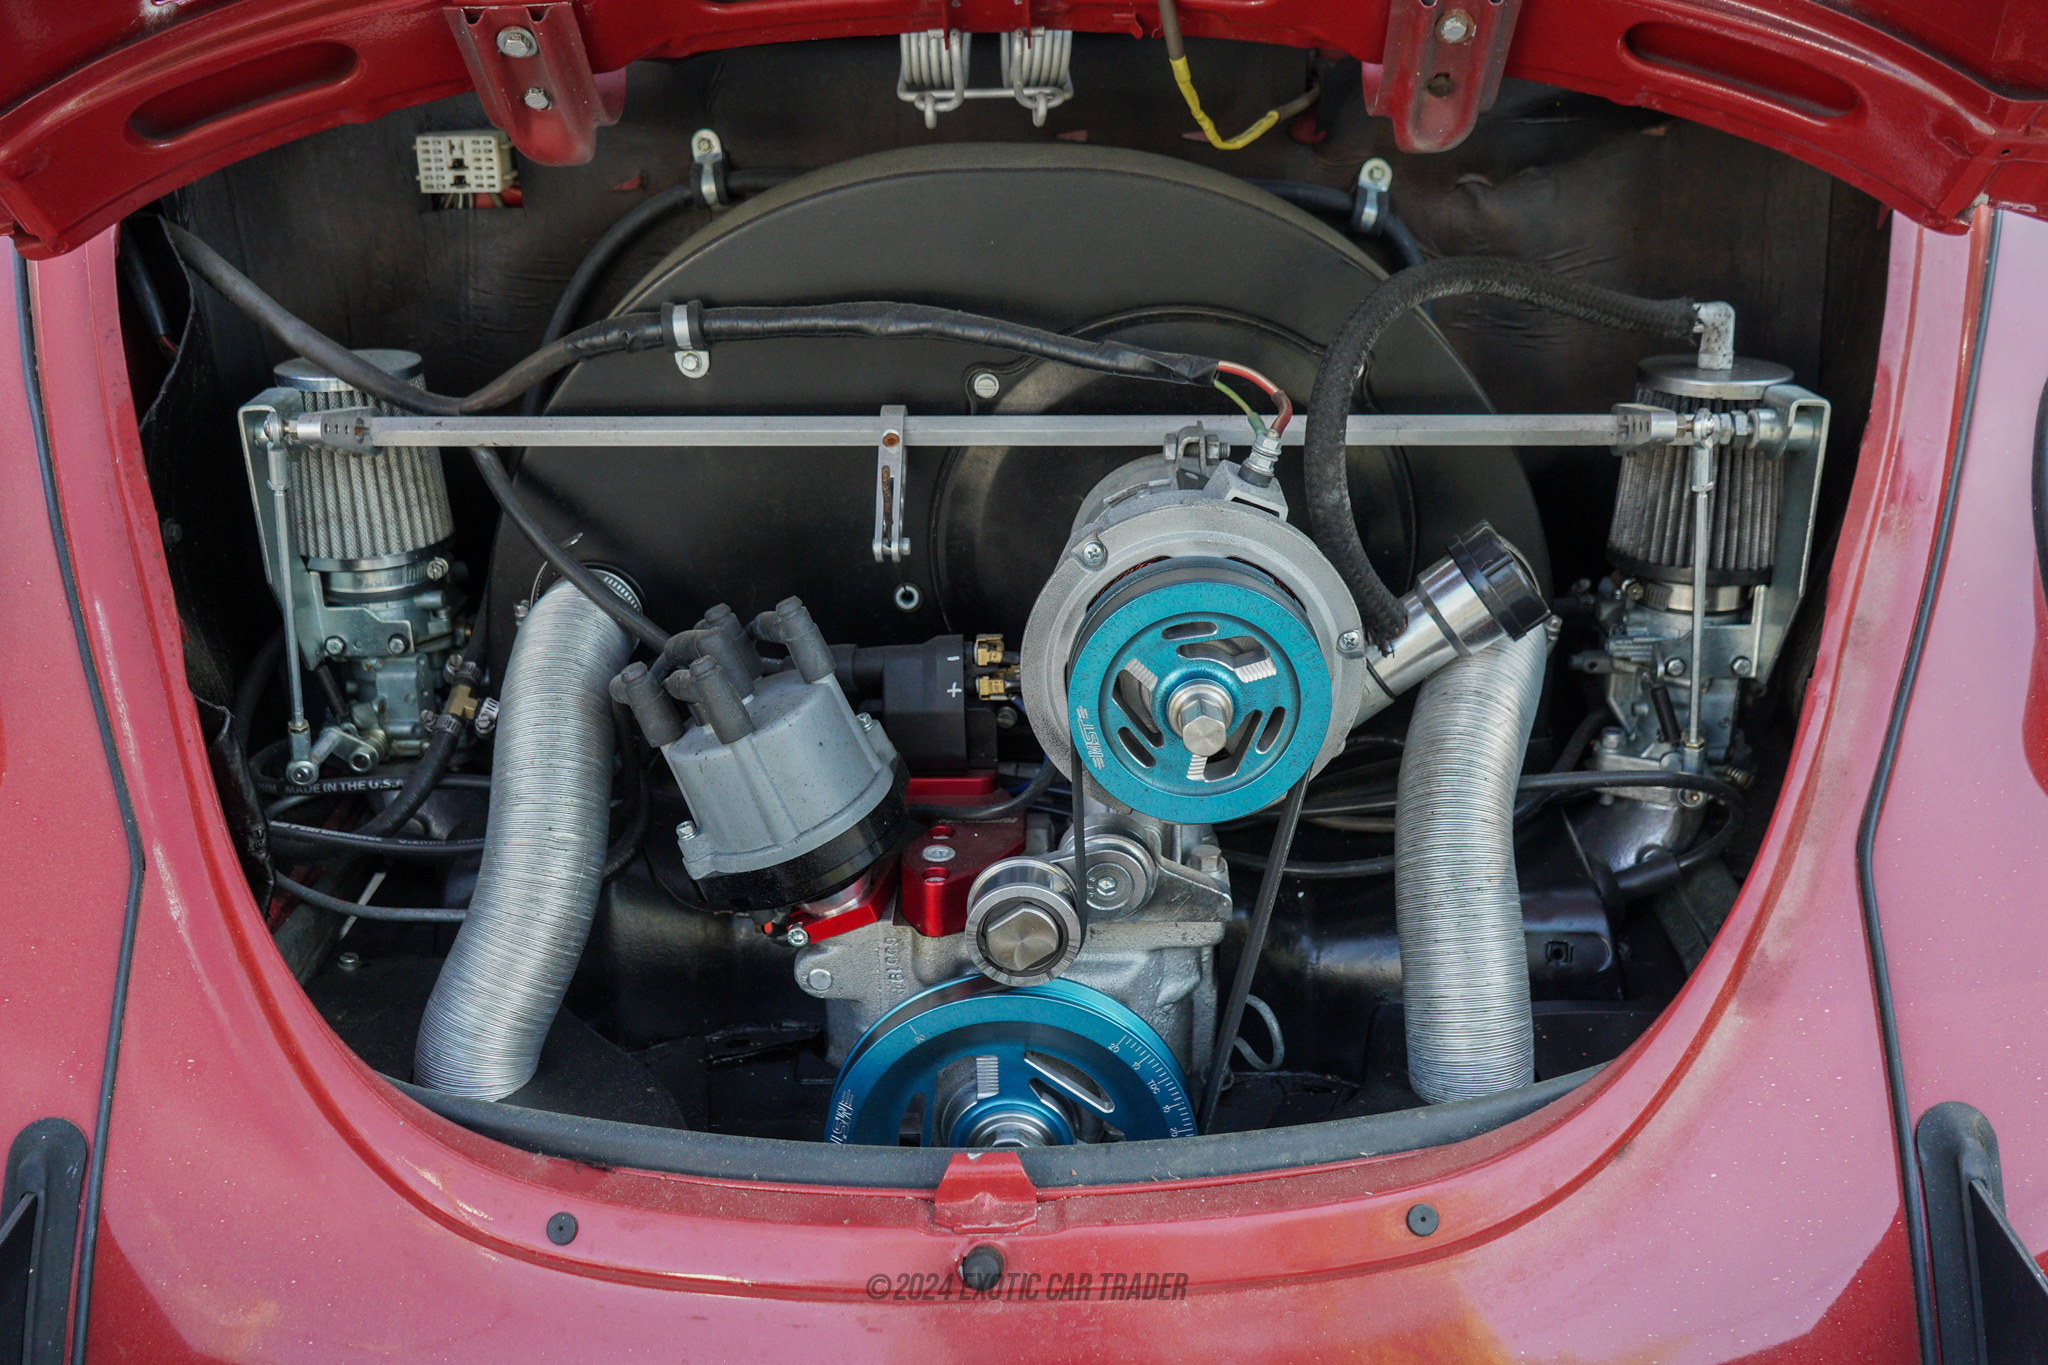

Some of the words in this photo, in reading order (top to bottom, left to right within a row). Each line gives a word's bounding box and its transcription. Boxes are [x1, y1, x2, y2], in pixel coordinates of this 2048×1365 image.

[284, 783, 321, 795] MADE
[322, 782, 338, 793] IN
[338, 780, 367, 792] THE
[1108, 1042, 1120, 1053] 20
[1132, 1061, 1141, 1071] 10
[1147, 1079, 1161, 1095] TDC
[1169, 1127, 1179, 1138] 20
